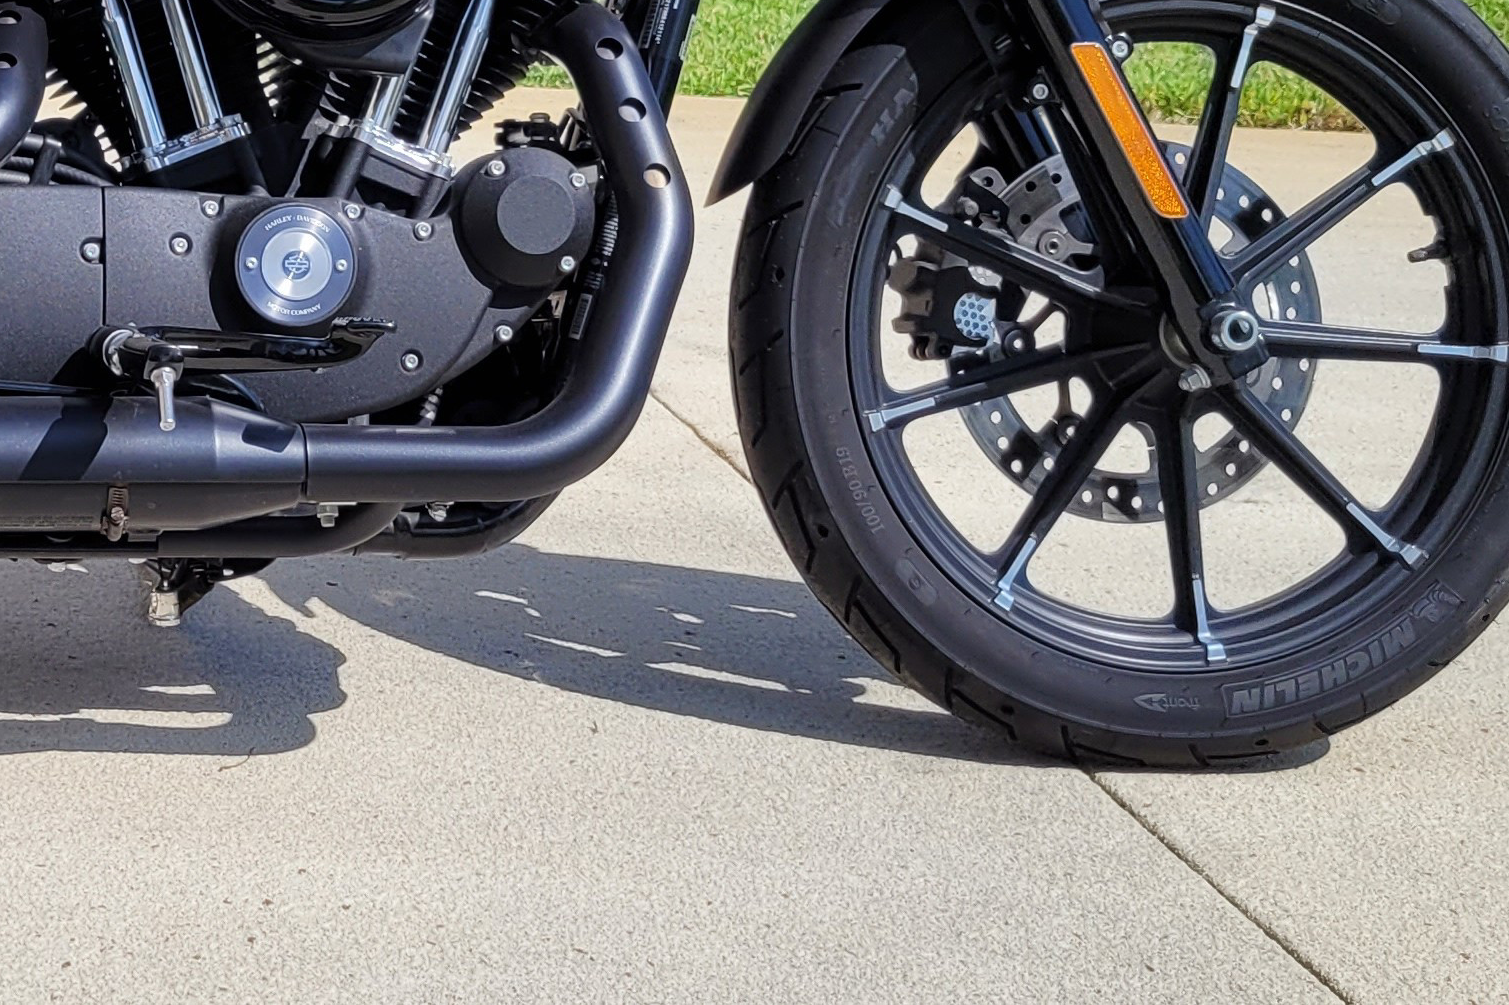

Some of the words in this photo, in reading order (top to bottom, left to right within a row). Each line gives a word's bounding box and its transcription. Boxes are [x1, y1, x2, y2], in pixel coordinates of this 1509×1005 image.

[266, 301, 291, 316] MOTOR
[291, 303, 322, 317] COMPANY
[1230, 612, 1417, 715] MICHELIN
